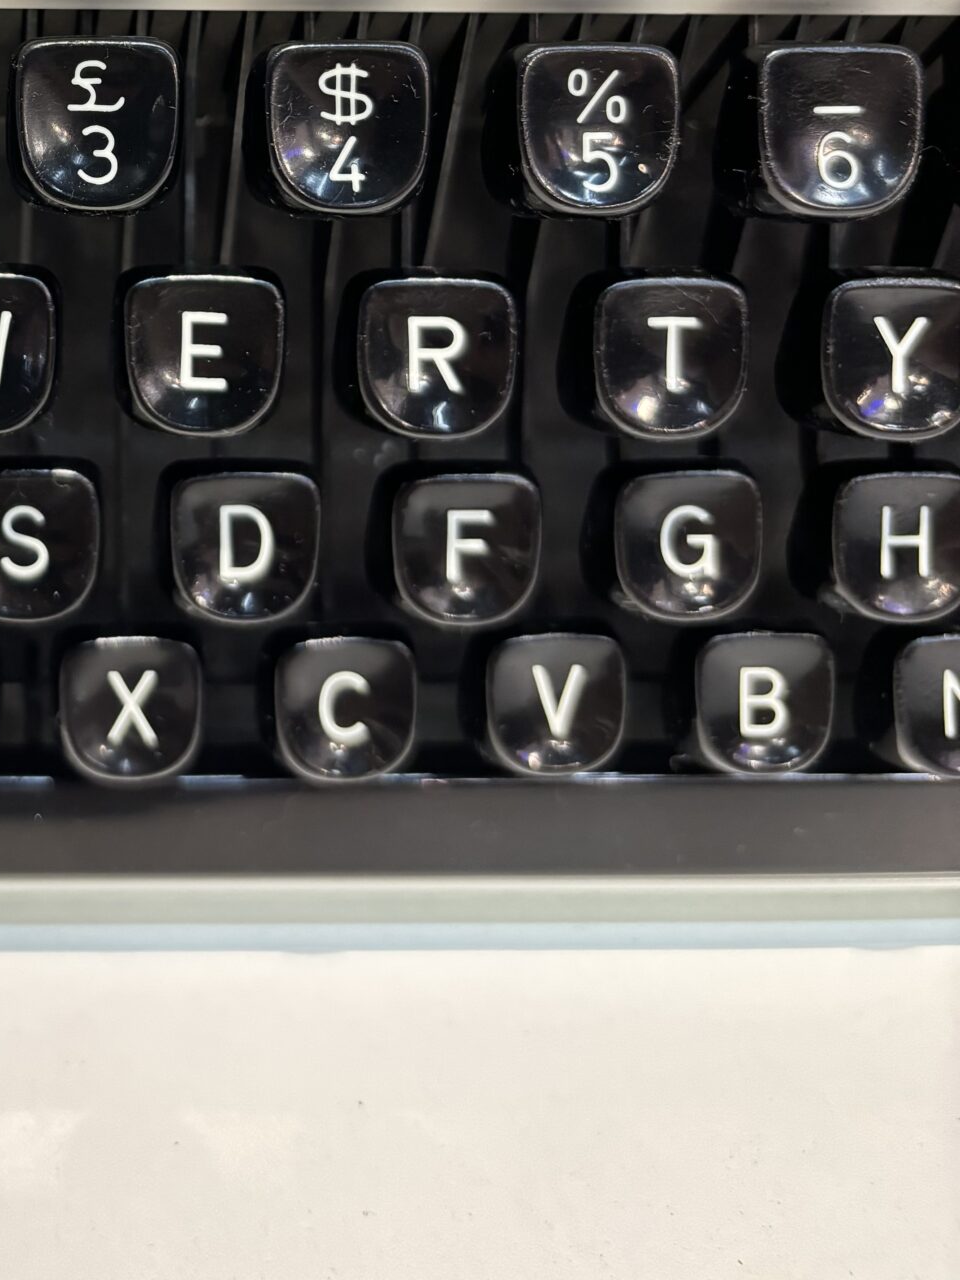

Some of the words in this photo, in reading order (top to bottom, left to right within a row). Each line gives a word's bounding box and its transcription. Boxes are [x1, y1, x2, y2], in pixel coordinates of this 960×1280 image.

[68, 61, 125, 112] £
[318, 62, 373, 126] $
[567, 68, 627, 124] %
[77, 124, 118, 185] 3
[328, 136, 368, 193] 4
[582, 131, 621, 195] 5
[817, 131, 860, 190] 6
[180, 310, 228, 390] E
[407, 316, 465, 393] R
[647, 316, 700, 392] T
[873, 316, 928, 393] Y
[0, 505, 49, 580] S
[219, 505, 273, 581] D
[446, 509, 494, 583] F
[660, 505, 718, 578] G
[880, 505, 931, 578] H
[107, 670, 157, 745] X
[318, 670, 370, 744] C
[531, 664, 585, 737] V
[739, 666, 789, 737] B
